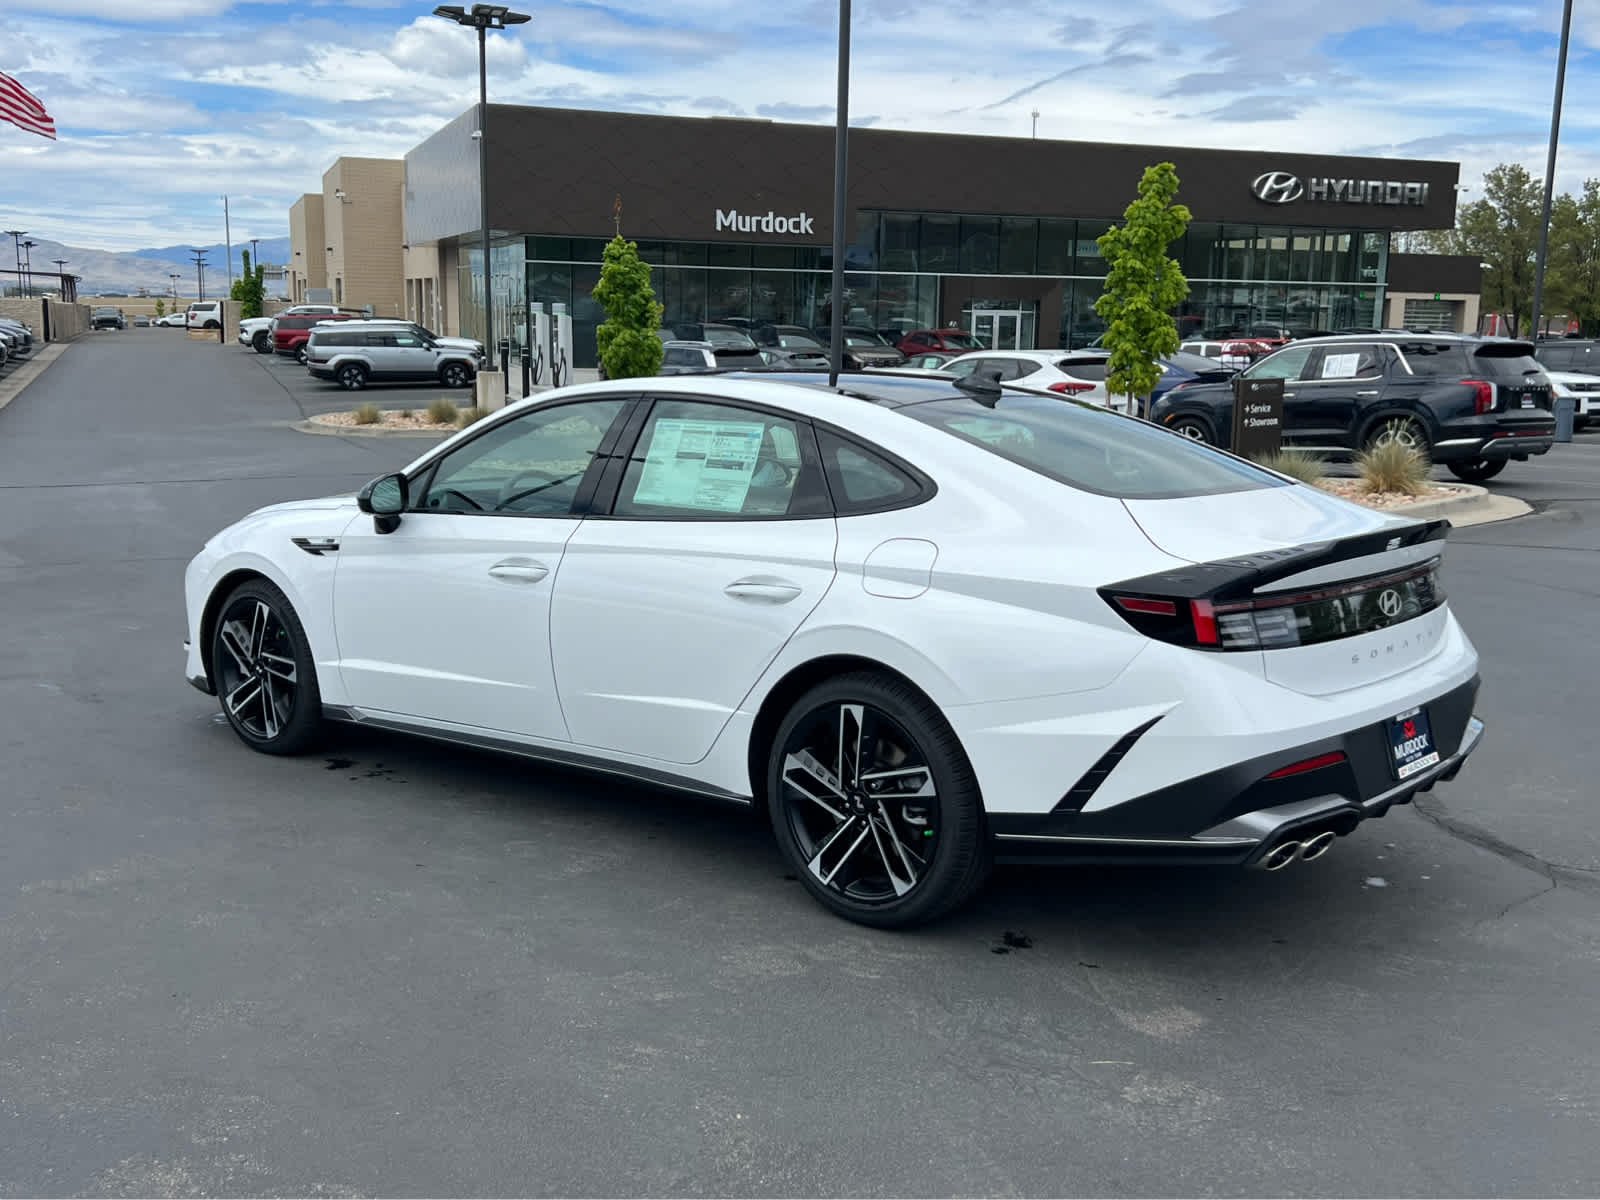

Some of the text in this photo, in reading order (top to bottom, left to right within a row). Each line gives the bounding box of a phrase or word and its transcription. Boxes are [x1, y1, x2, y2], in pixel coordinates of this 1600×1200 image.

[1309, 177, 1429, 205] HYUNDAI
[715, 208, 814, 235] Murdock
[1250, 403, 1272, 414] Service
[1250, 417, 1278, 427] Showroom
[1394, 733, 1429, 760] MURDOCK
